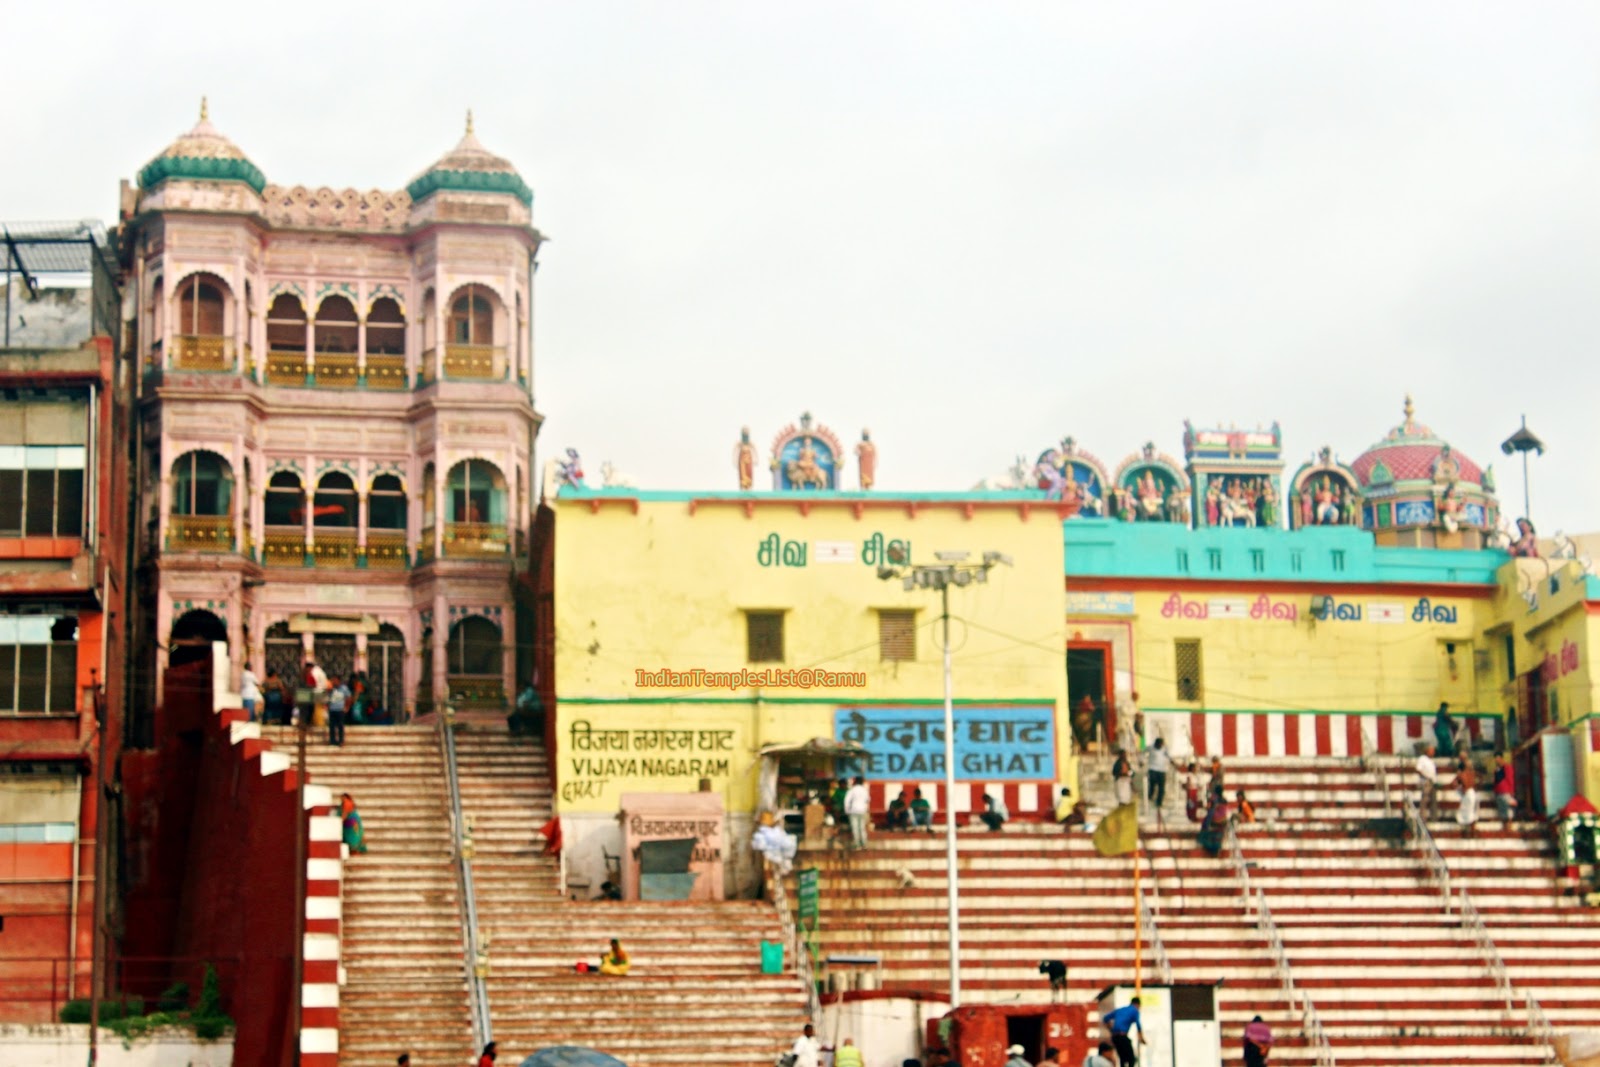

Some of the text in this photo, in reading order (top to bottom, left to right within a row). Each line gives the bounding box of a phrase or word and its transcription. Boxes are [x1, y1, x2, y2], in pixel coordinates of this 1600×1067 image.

[757, 532, 807, 567] சிவ
[1161, 592, 1208, 619] சிவ
[1250, 592, 1297, 621] சிவ
[1412, 597, 1457, 623] சிவ
[698, 729, 735, 751] घाट
[968, 719, 1049, 744] घाट
[961, 753, 1049, 773] GHAT
